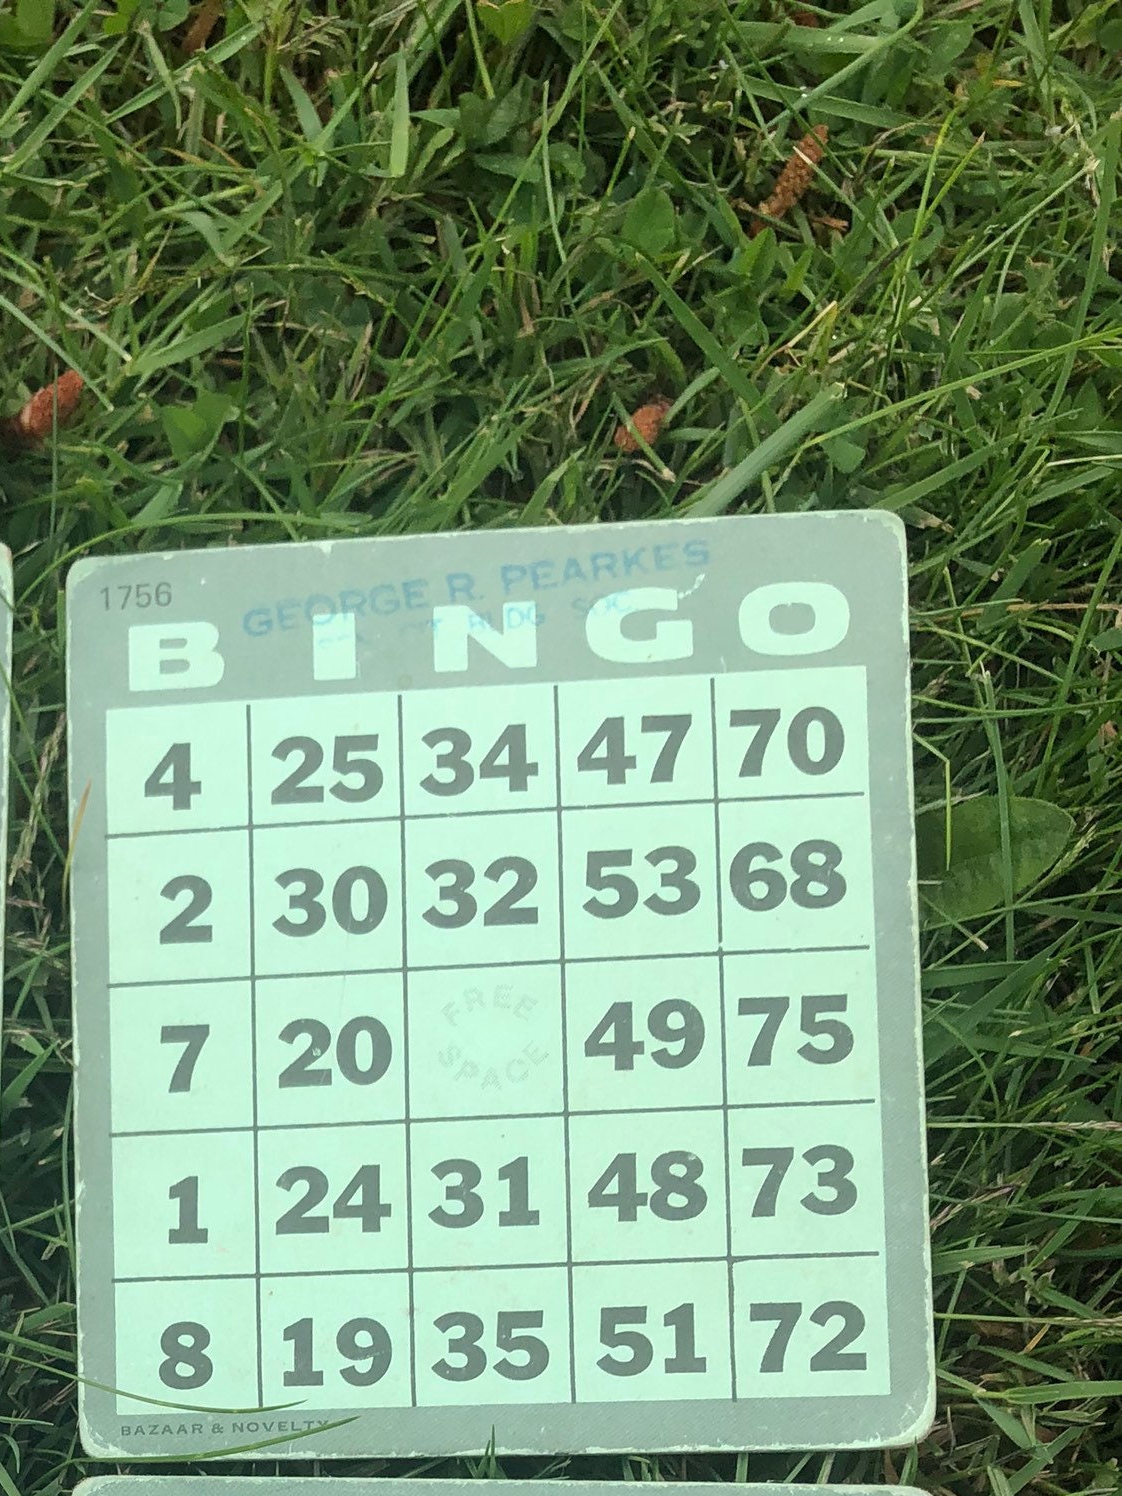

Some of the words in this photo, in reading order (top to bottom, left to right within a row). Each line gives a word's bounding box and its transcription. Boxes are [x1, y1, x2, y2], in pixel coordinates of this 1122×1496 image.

[100, 581, 173, 612] 1756
[242, 577, 429, 638] GEORGE
[500, 538, 711, 597] PEARKES
[145, 743, 201, 810] 4
[272, 734, 383, 804] 25
[420, 724, 538, 796] 34
[578, 715, 692, 784] 47
[730, 707, 844, 777] 70
[160, 875, 212, 944] 2
[273, 866, 387, 936] 30
[423, 857, 538, 928] 32
[583, 846, 700, 918] 53
[730, 840, 846, 911] 68
[161, 1025, 209, 1092] 7
[279, 1016, 392, 1088] 20
[585, 999, 705, 1070] 49
[738, 994, 854, 1066] 75
[169, 1176, 208, 1244] 1
[276, 1165, 391, 1235] 24
[428, 1157, 539, 1228] 31
[588, 1151, 707, 1221] 48
[742, 1145, 857, 1217] 73
[159, 1322, 213, 1390] 8
[284, 1318, 392, 1386] 19
[432, 1310, 549, 1381] 35
[597, 1303, 706, 1376] 51
[750, 1301, 867, 1373] 72
[120, 1423, 204, 1437] BAZAAR
[211, 1422, 225, 1435] &
